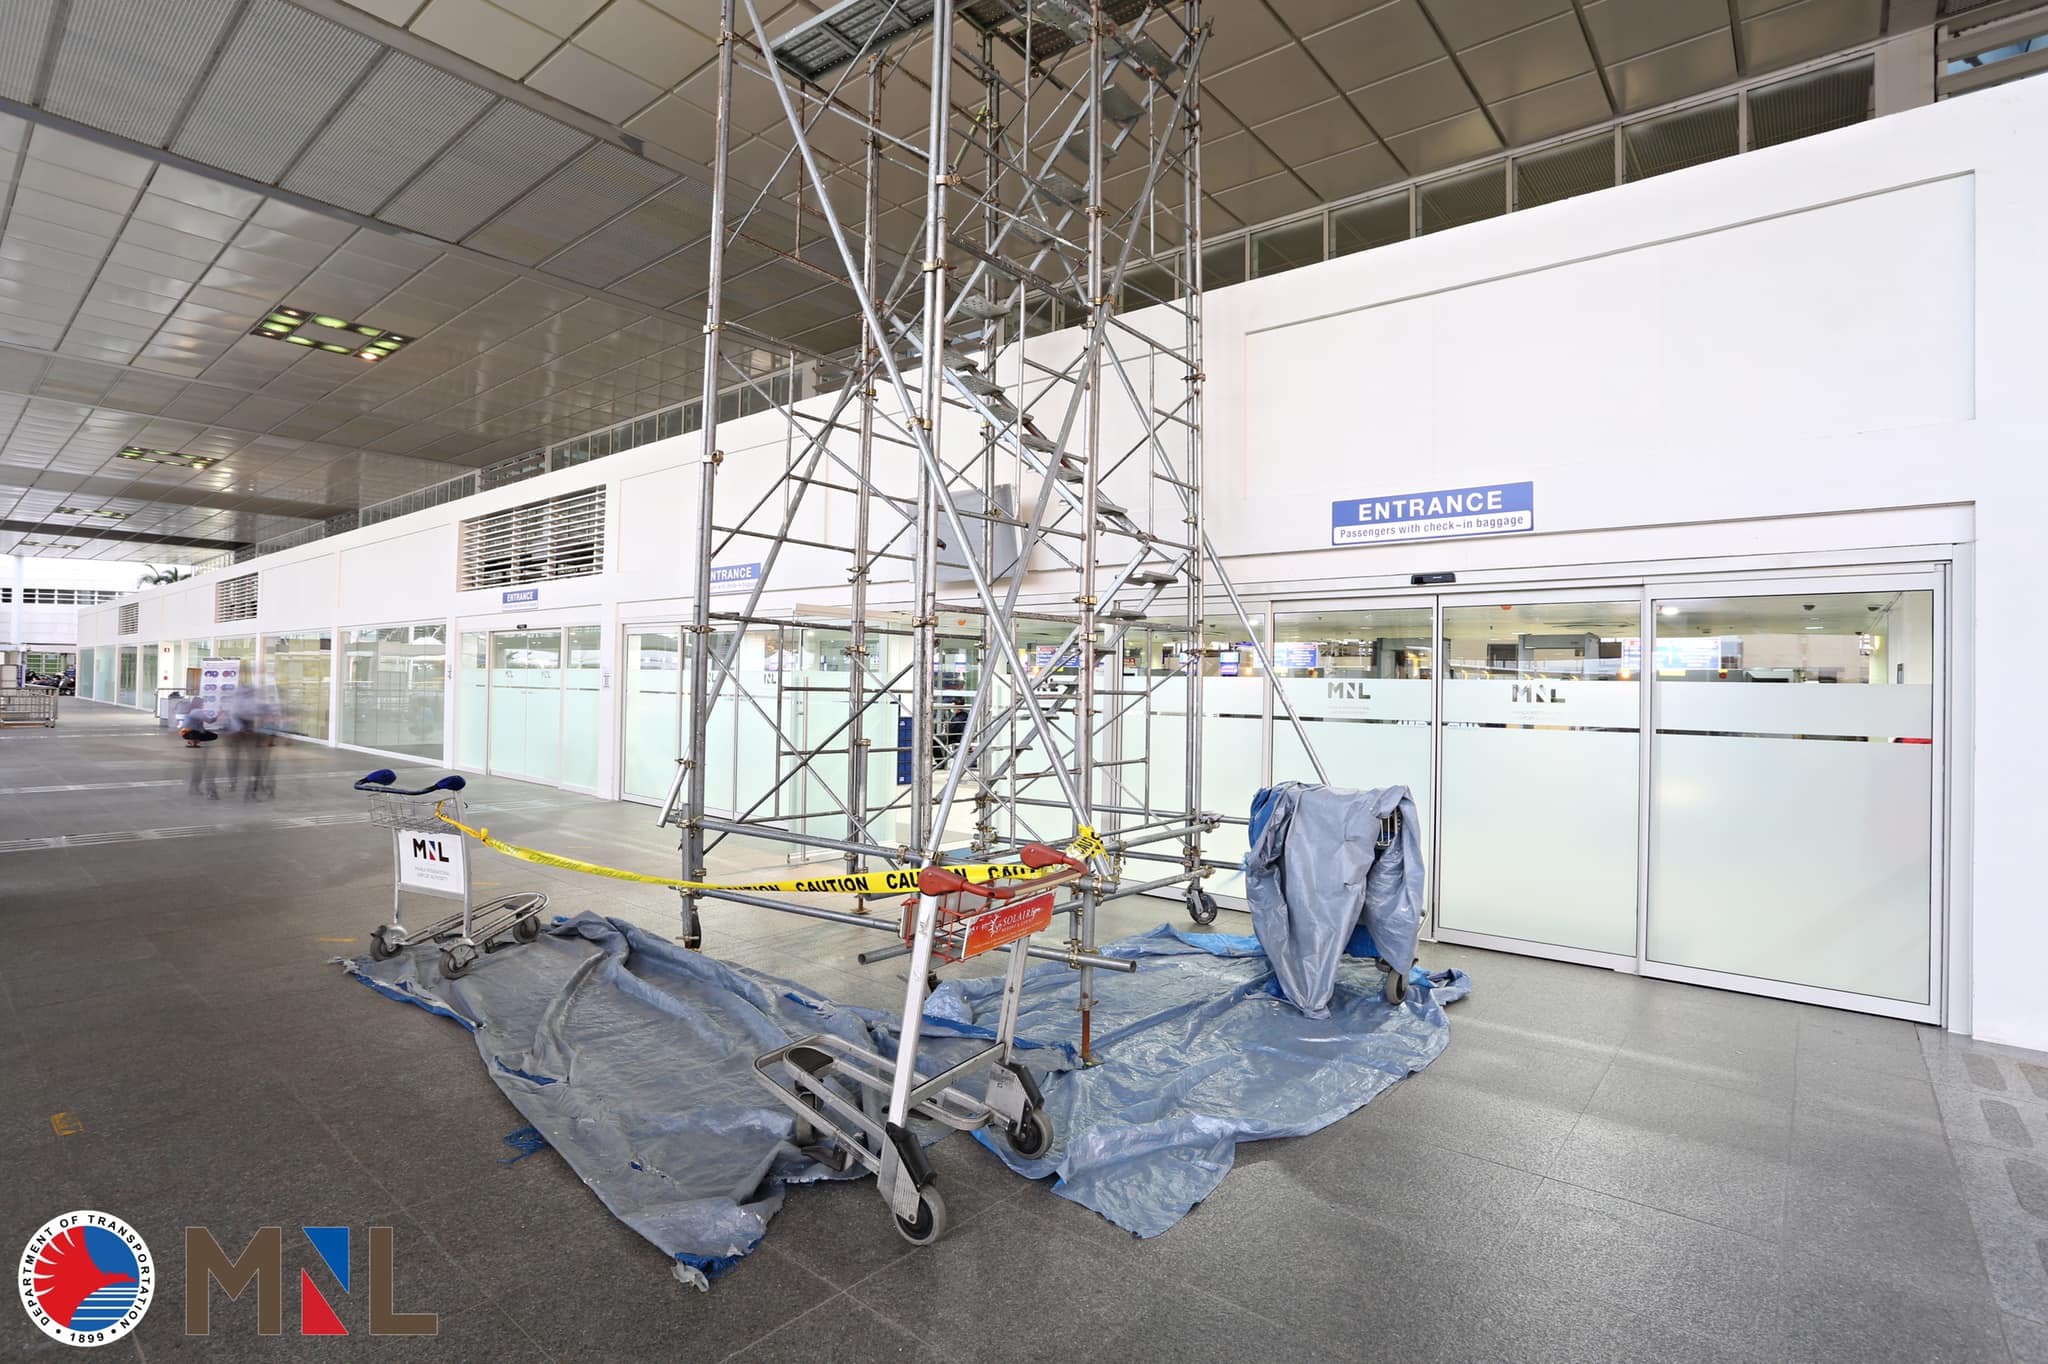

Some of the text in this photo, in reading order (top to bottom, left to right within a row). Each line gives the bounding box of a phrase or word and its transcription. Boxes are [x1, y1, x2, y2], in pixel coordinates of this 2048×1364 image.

[1358, 490, 1504, 522] ENTRANCE
[1340, 524, 1396, 539] Passengers
[1399, 522, 1421, 535] with
[1476, 516, 1524, 530] baggage
[710, 567, 752, 582] NTRANCE
[507, 591, 534, 602] ENTRANCE
[1327, 681, 1371, 700] MNL
[1512, 684, 1566, 703] MNL
[412, 838, 449, 863] MNL
[795, 876, 869, 893] CAUTION
